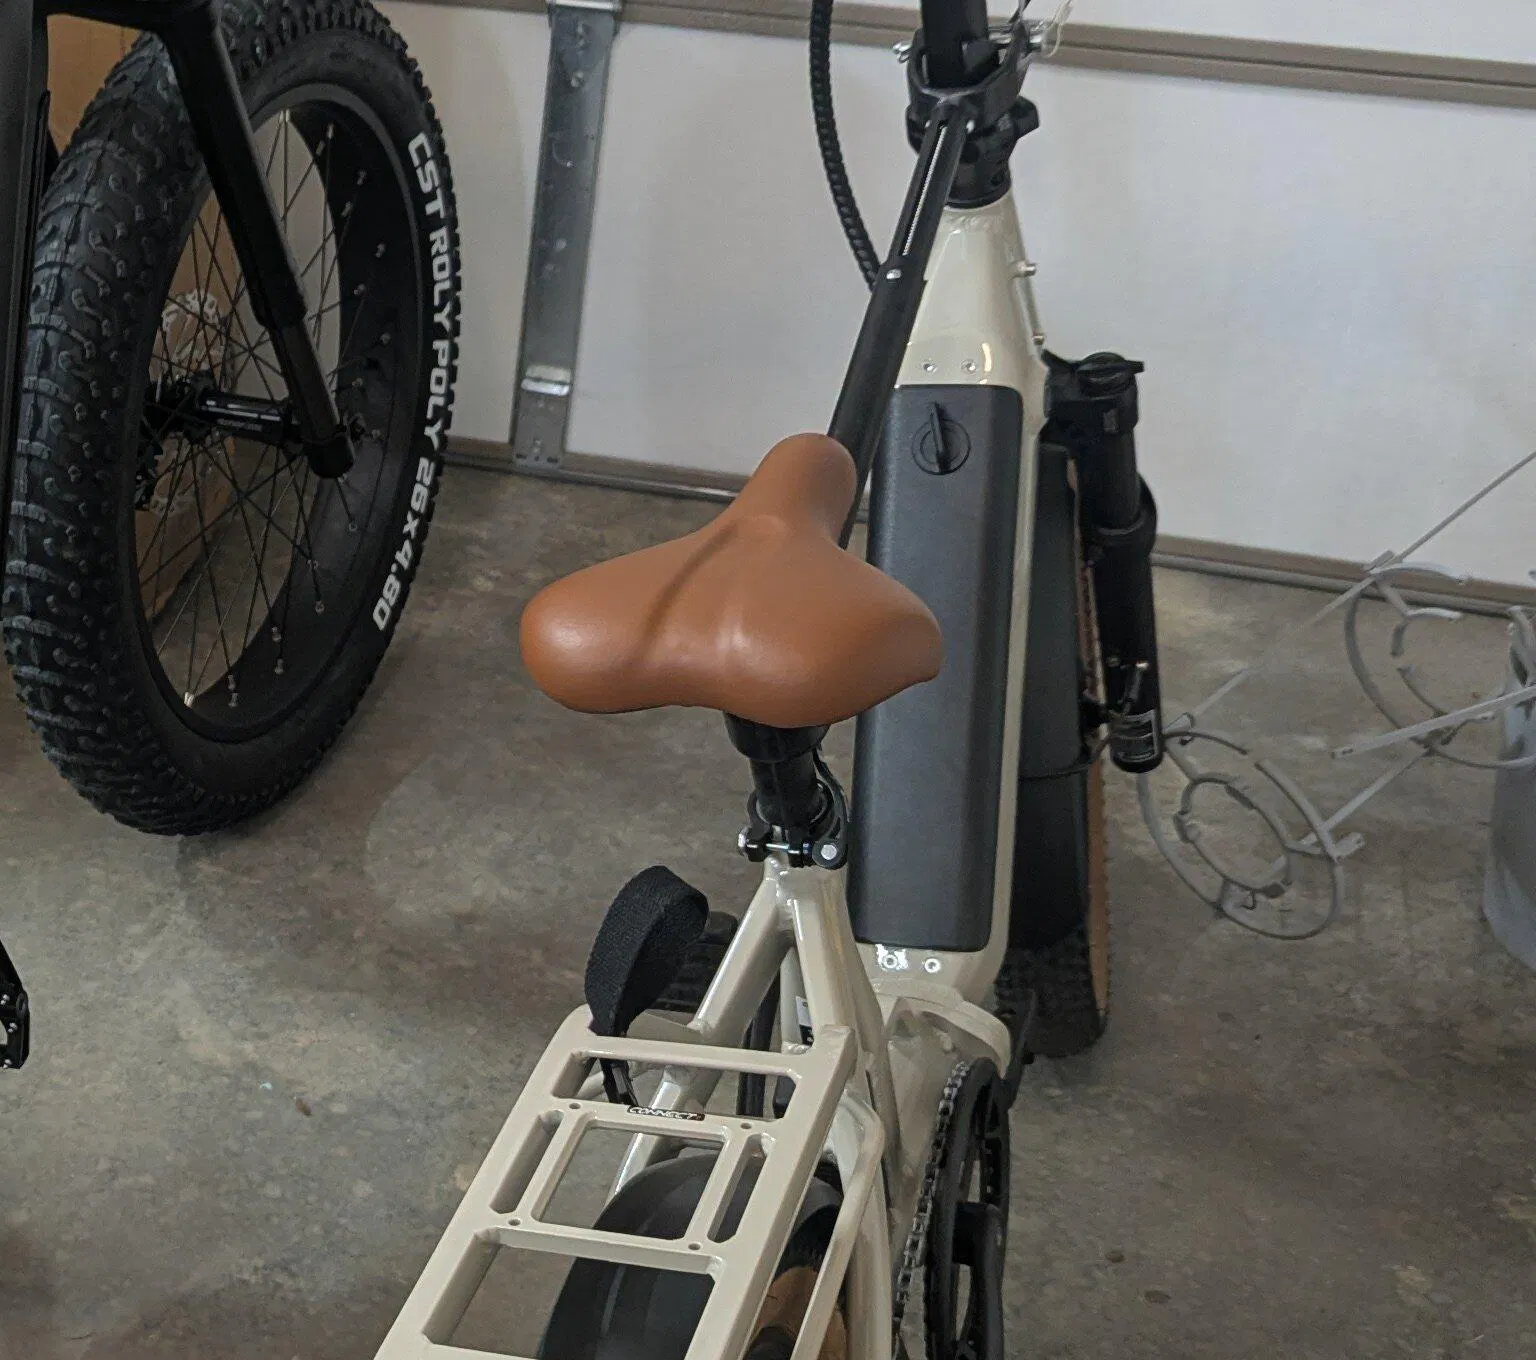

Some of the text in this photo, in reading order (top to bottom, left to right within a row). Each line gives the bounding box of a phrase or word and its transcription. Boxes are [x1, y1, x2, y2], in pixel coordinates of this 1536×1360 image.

[408, 132, 445, 219] CST
[429, 225, 452, 332] ROLY
[424, 339, 450, 451] POLY
